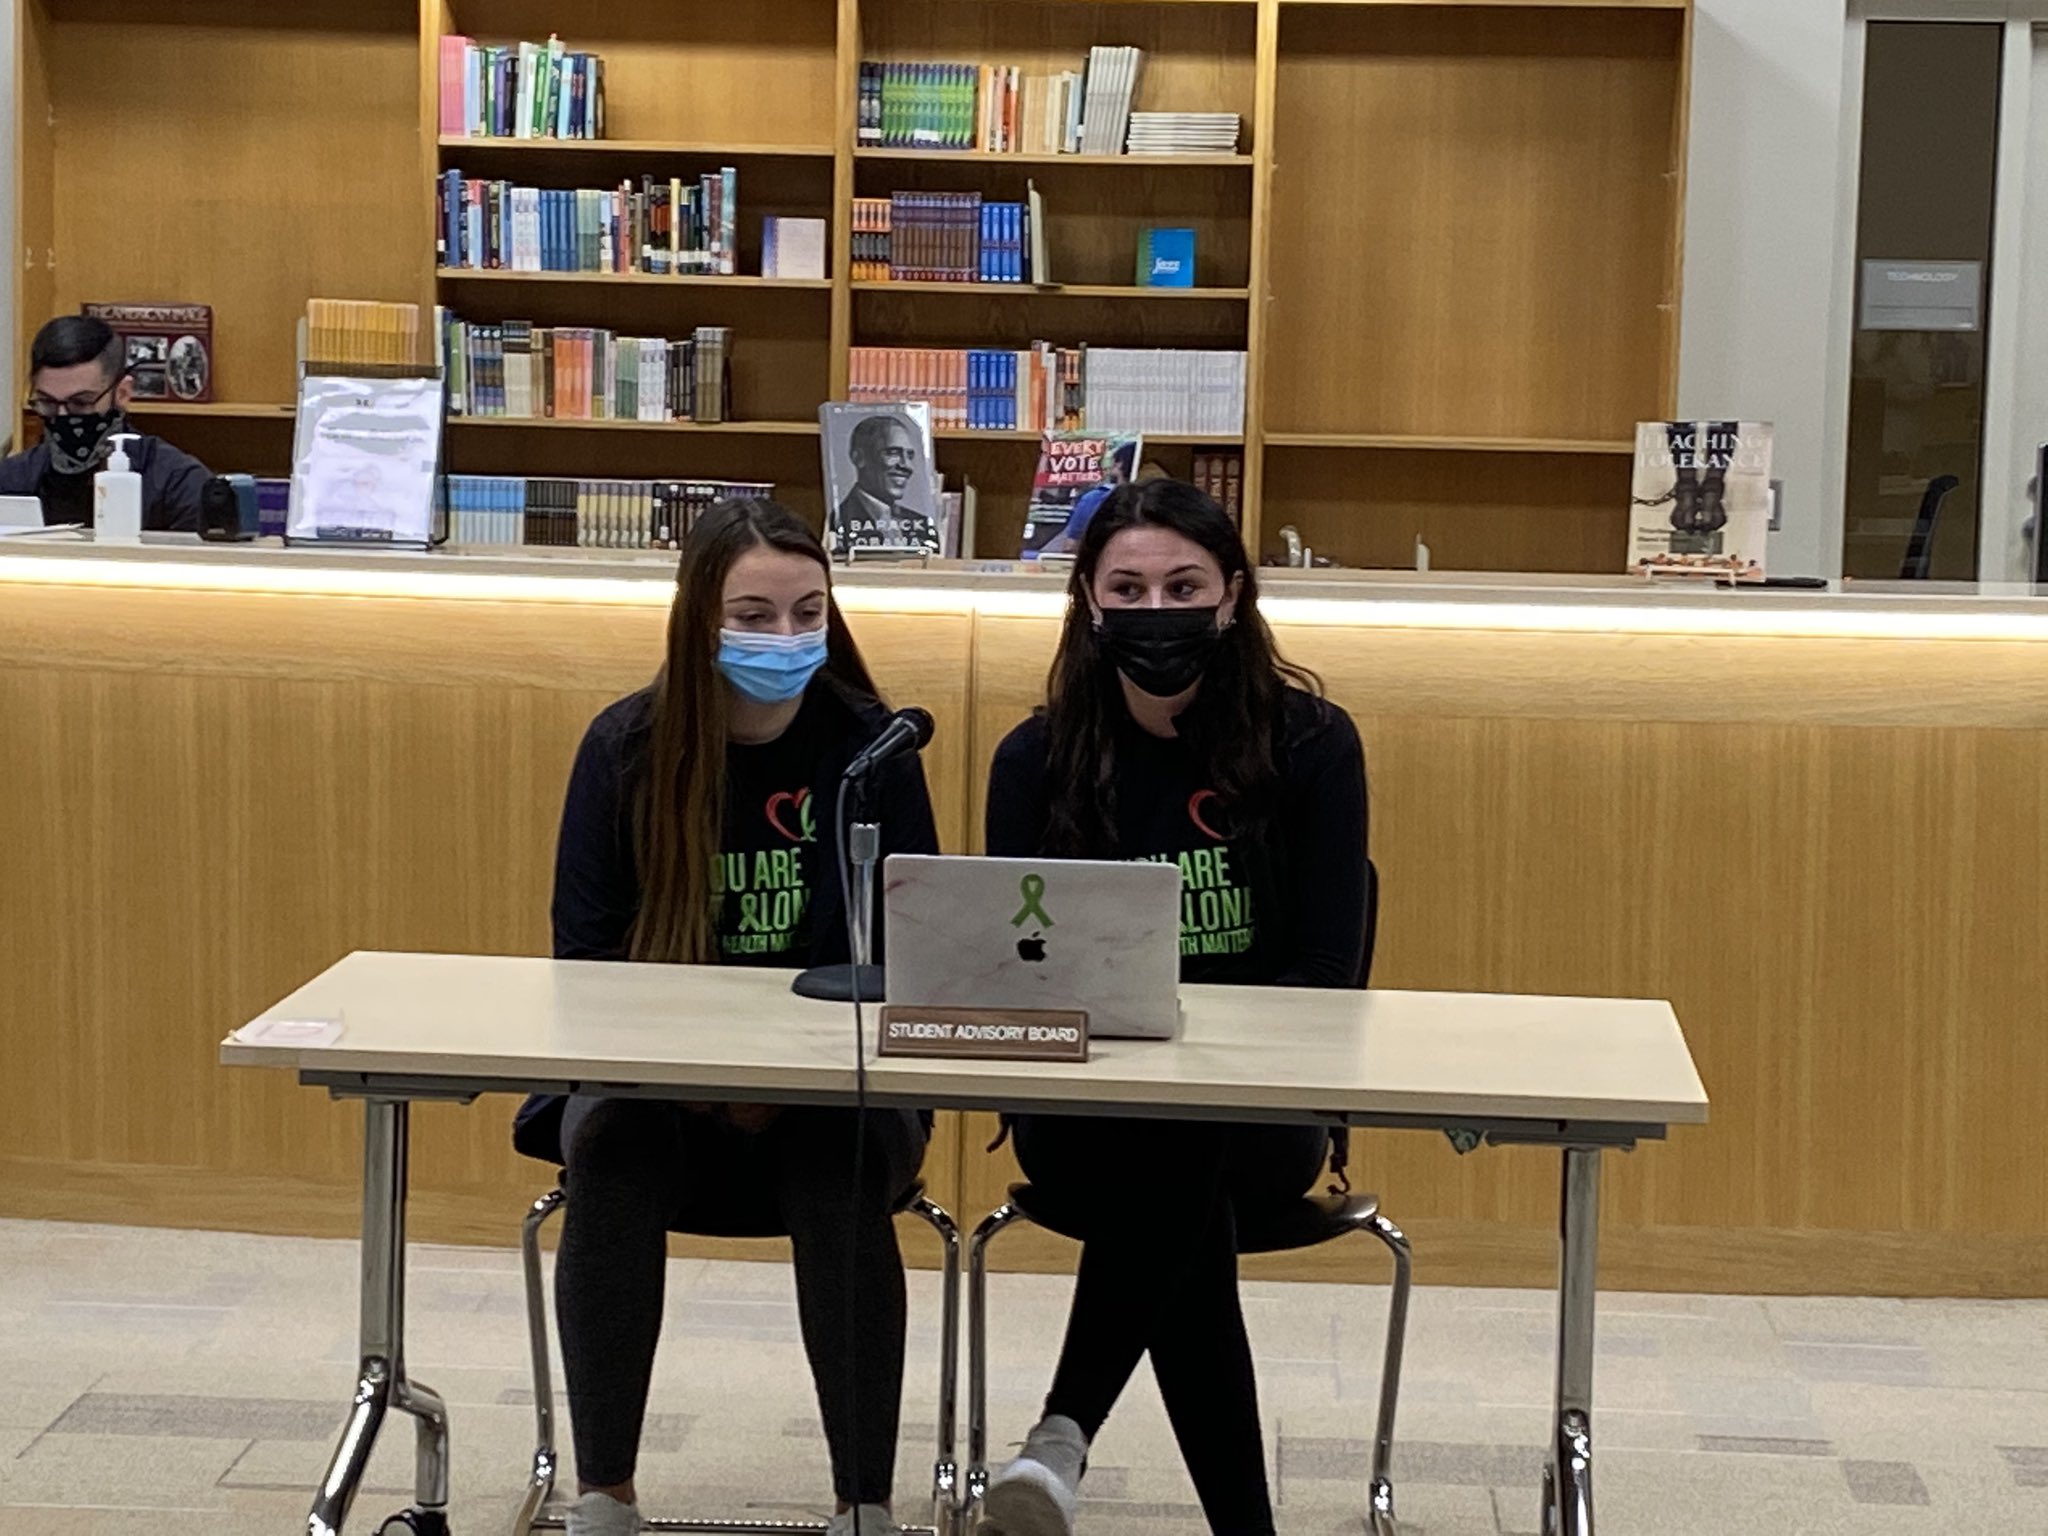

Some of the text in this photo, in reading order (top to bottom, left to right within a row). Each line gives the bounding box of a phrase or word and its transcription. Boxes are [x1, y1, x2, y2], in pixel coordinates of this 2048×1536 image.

[1050, 440, 1106, 456] EVERY
[1049, 455, 1101, 473] VOTE
[1047, 471, 1103, 483] MATTERS
[850, 519, 926, 532] BARACK
[709, 847, 804, 892] OU ARE
[1178, 847, 1232, 890] ARE
[738, 888, 811, 933] ALON
[1181, 887, 1252, 934] LON
[889, 1023, 1079, 1043] STUDENT ADVISORY BOARD
